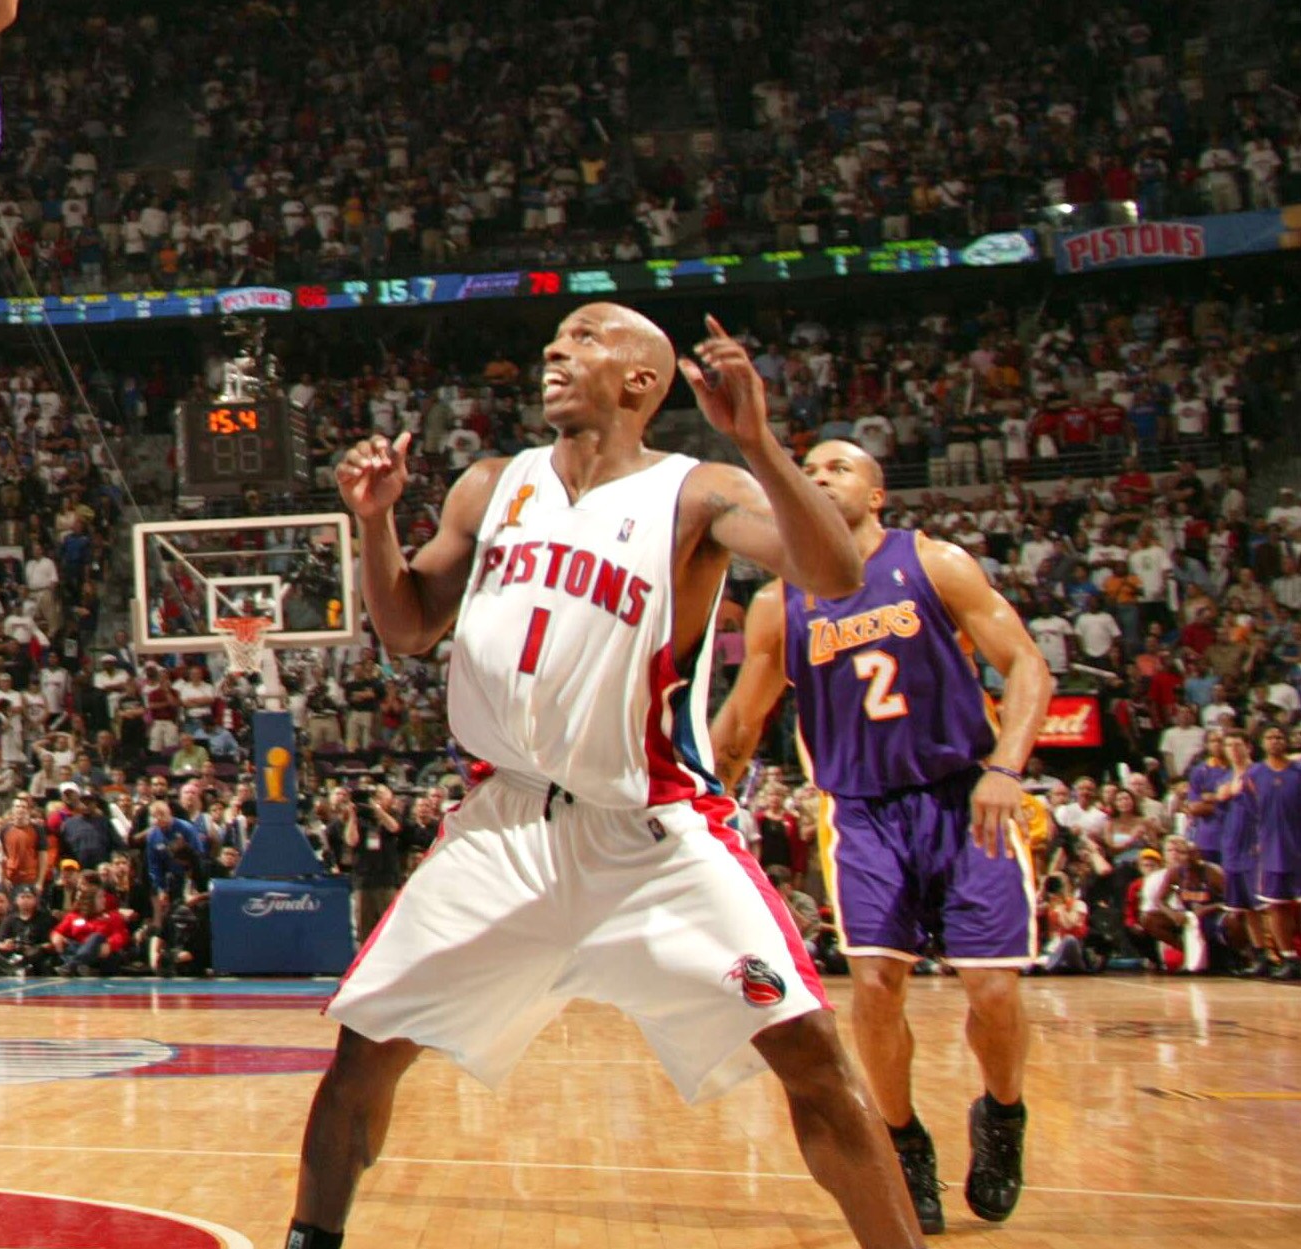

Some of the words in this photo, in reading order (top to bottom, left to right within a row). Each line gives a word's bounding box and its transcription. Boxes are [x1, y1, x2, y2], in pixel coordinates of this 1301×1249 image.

[1064, 220, 1205, 273] PISTONS
[473, 540, 653, 628] PISTONS
[517, 606, 552, 675] 1
[807, 599, 922, 666] LAKERS
[852, 648, 909, 722] 2
[257, 891, 321, 914] Finals
